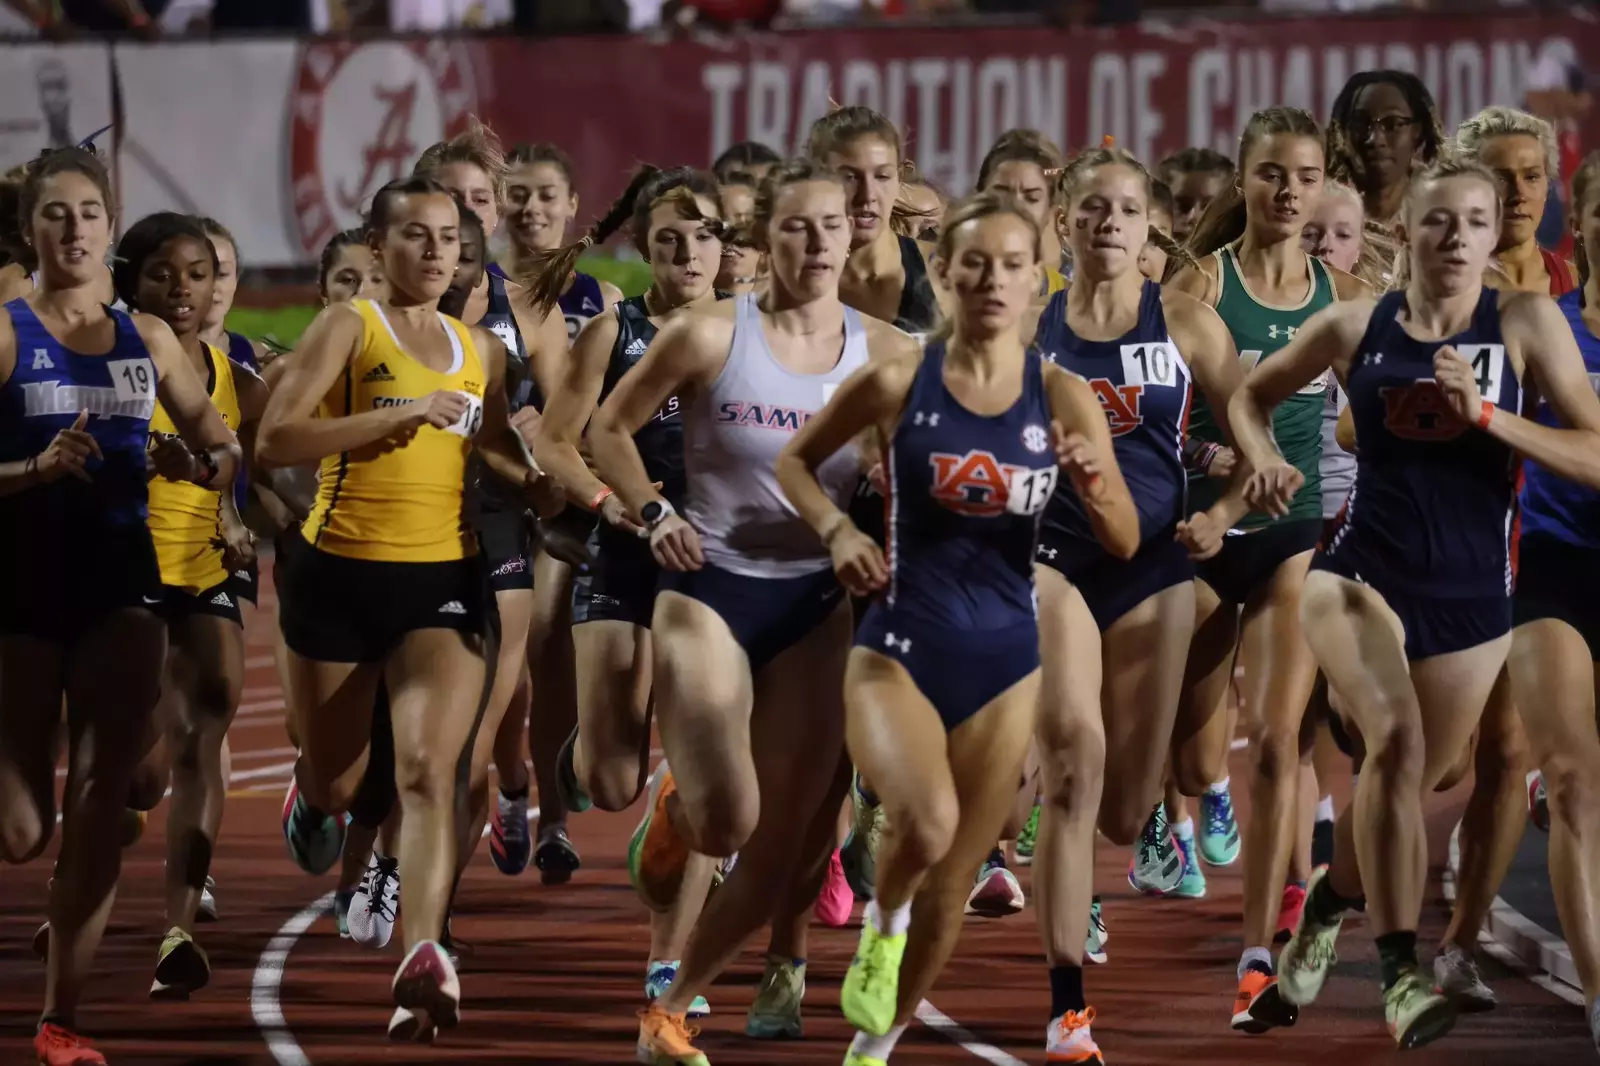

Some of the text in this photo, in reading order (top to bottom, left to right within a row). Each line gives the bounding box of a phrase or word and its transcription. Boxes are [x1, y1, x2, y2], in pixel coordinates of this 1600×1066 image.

[1088, 50, 1168, 172] OF
[122, 365, 150, 394] 19
[1132, 346, 1170, 384] 10
[1022, 471, 1052, 512] 13
